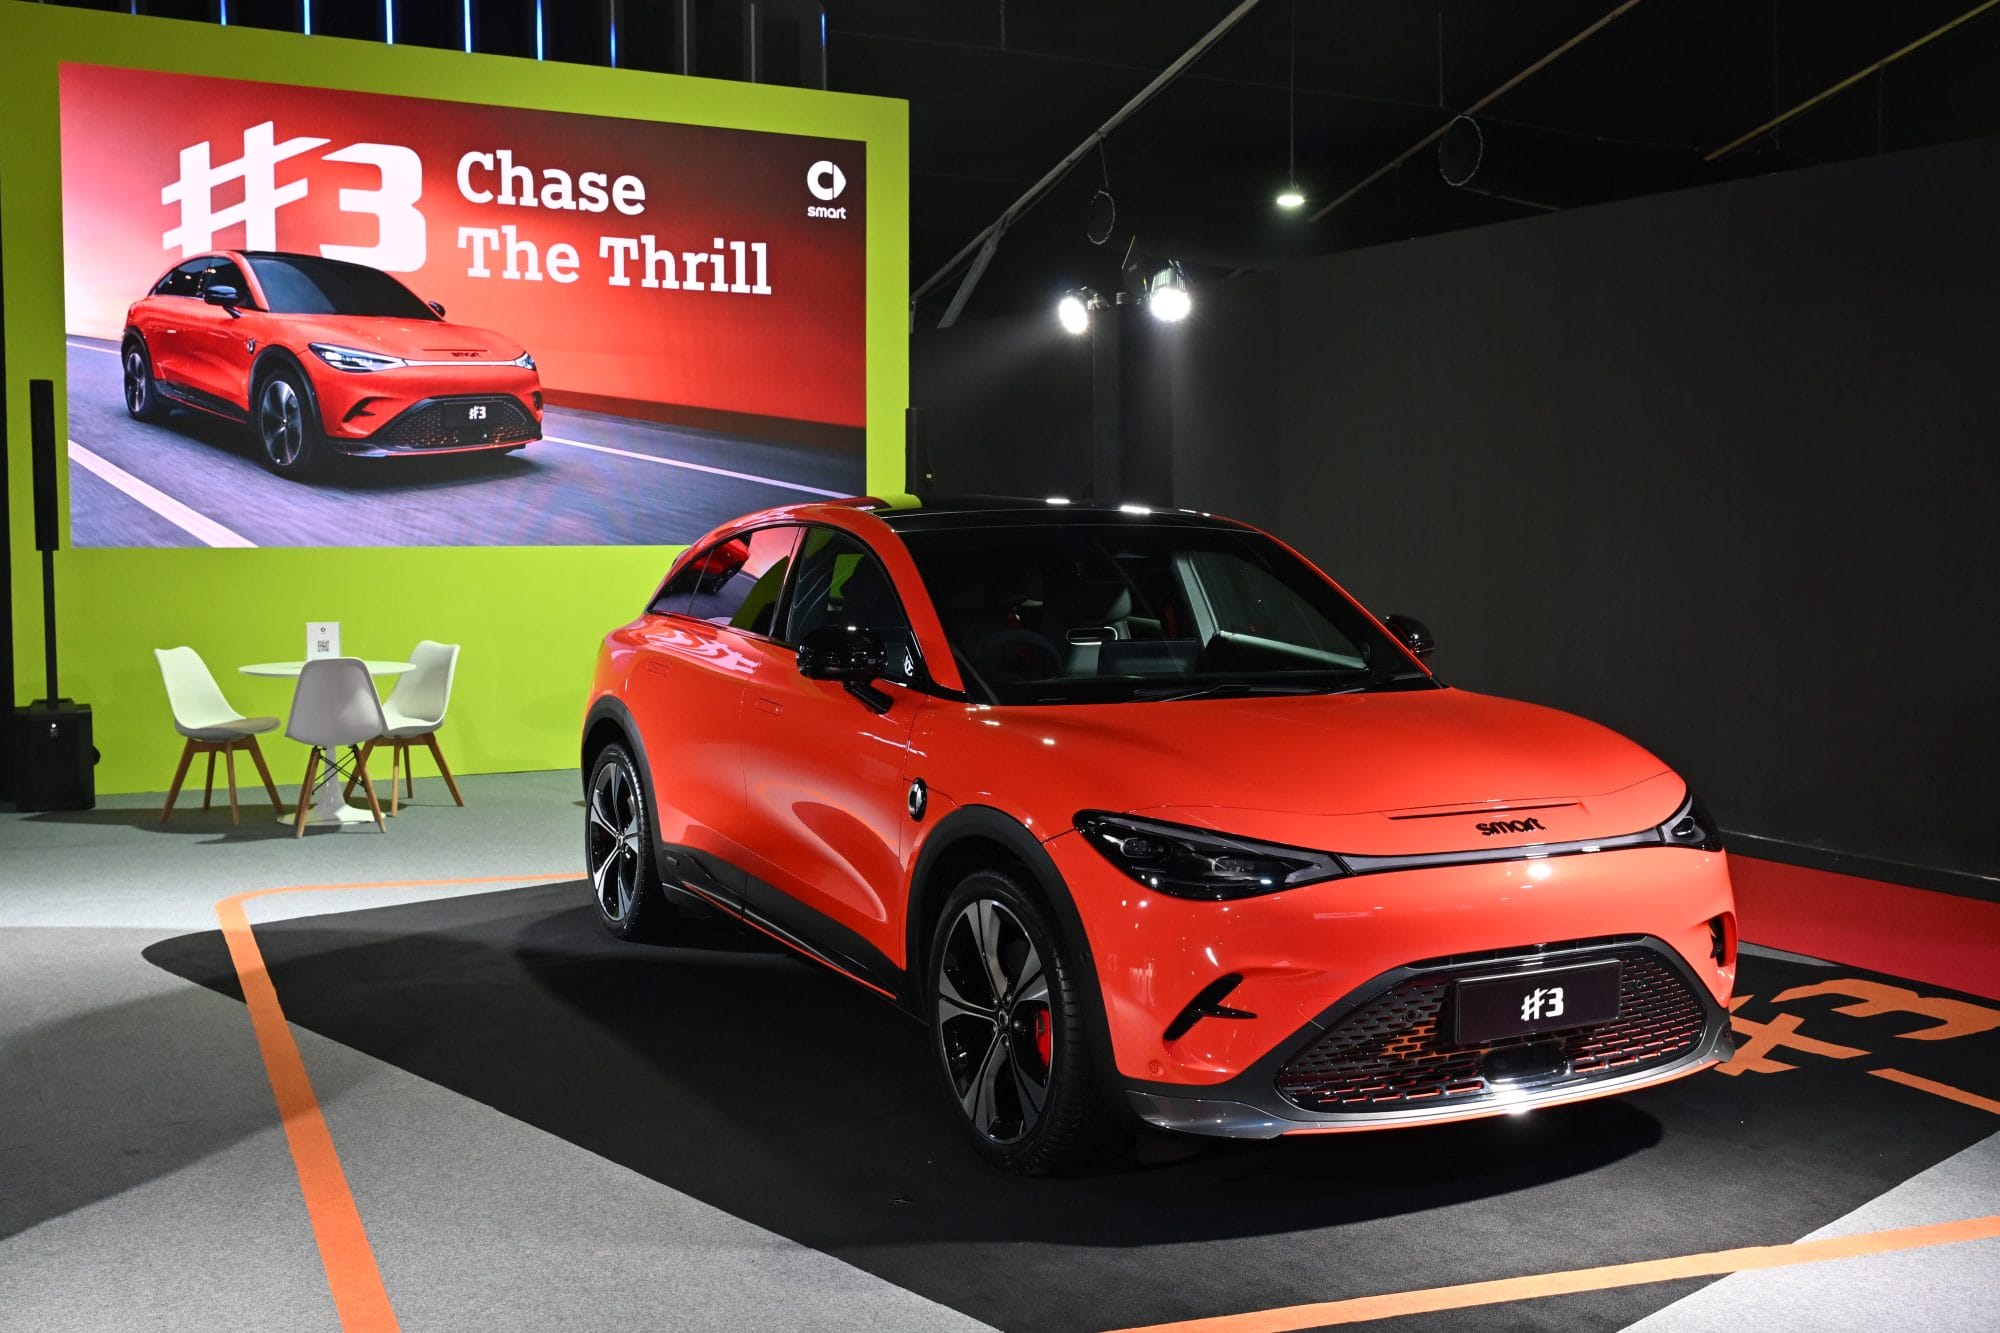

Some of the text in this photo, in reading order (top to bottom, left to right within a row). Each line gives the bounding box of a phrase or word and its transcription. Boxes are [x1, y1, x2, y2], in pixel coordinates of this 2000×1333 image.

[161, 120, 427, 273] #3
[456, 149, 646, 216] Chase
[807, 205, 847, 220] smart
[457, 225, 772, 295] The Thrill
[468, 405, 487, 420] #3
[1475, 817, 1546, 837] smart
[1521, 986, 1564, 1021] #3
